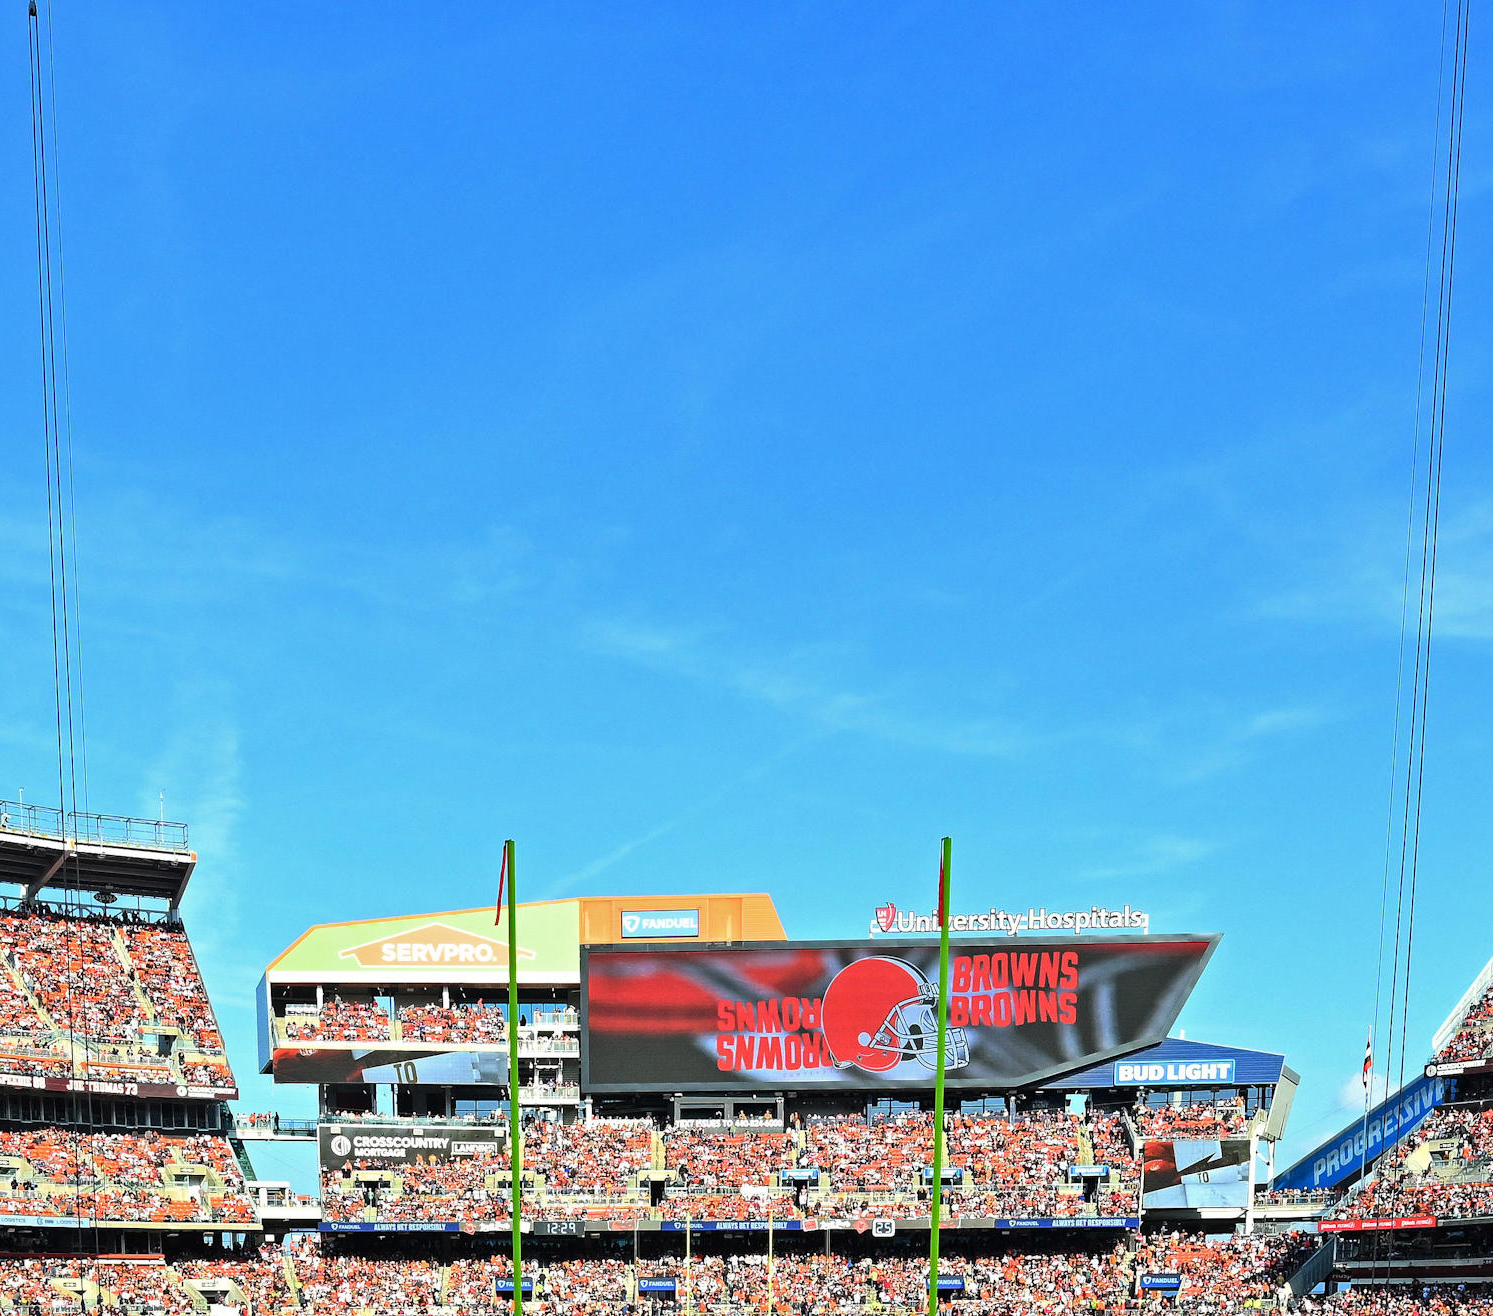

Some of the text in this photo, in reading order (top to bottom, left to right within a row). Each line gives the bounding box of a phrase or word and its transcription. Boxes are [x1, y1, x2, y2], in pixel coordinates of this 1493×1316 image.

[643, 918, 698, 929] FANDUEL
[1028, 905, 1143, 934] Hospitals
[951, 952, 1079, 994] BROWNS
[951, 989, 1078, 1027] BROWNS
[393, 1061, 418, 1084] TO
[1119, 1062, 1231, 1082] BUD LIGHT
[353, 1136, 449, 1149] CROSSCOUNTRY
[354, 1148, 406, 1157] MORTGAGE
[547, 1223, 576, 1234] 12:29
[875, 1223, 892, 1233] 25
